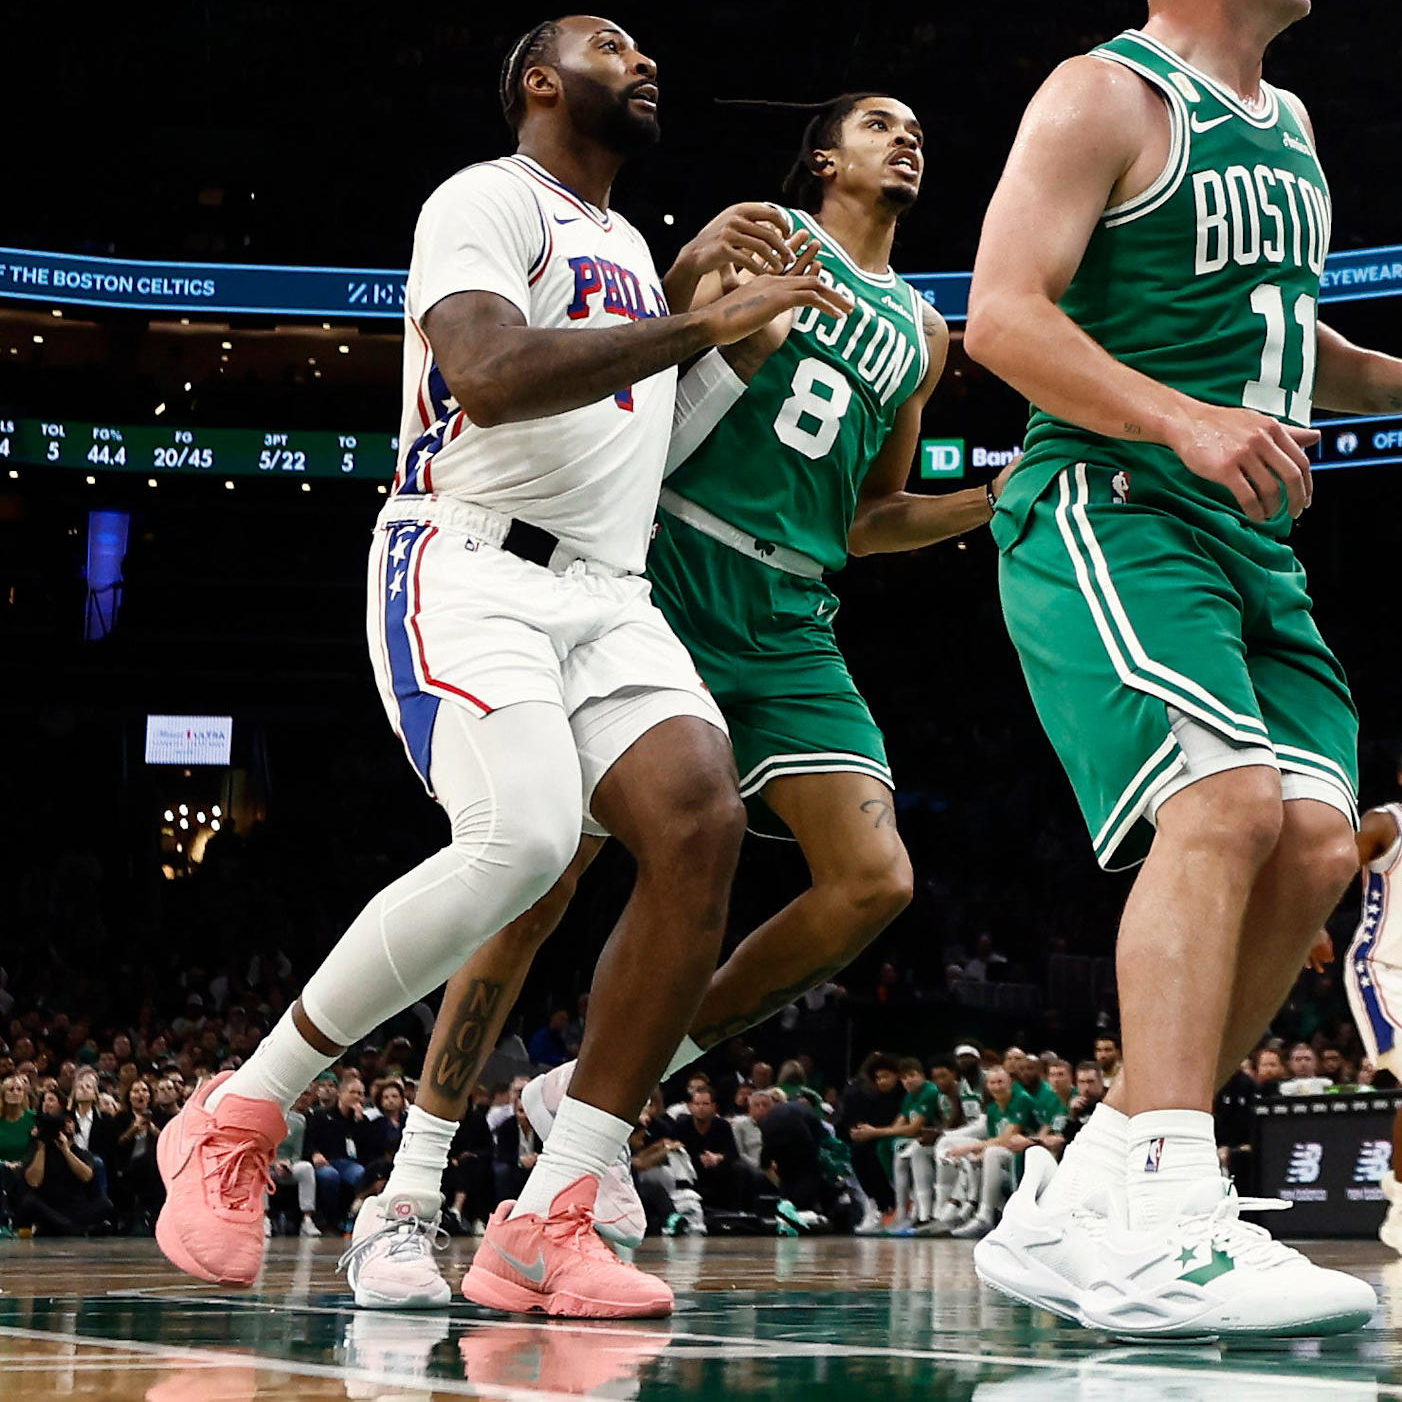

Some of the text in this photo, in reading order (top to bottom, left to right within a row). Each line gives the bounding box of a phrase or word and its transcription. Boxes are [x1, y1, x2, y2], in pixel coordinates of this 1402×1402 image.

[10, 265, 215, 296] THE BOSTON CELTICS
[792, 269, 916, 407] OSTON
[1241, 283, 1319, 429] 11
[773, 356, 852, 461] 8
[41, 423, 357, 449] TOL FG% FG 3PT TO
[46, 441, 60, 461] 5
[87, 446, 127, 467] 44.4
[153, 447, 213, 468] 20/45
[258, 450, 306, 472] 5/22
[341, 451, 354, 473] 5
[925, 445, 960, 471] TD
